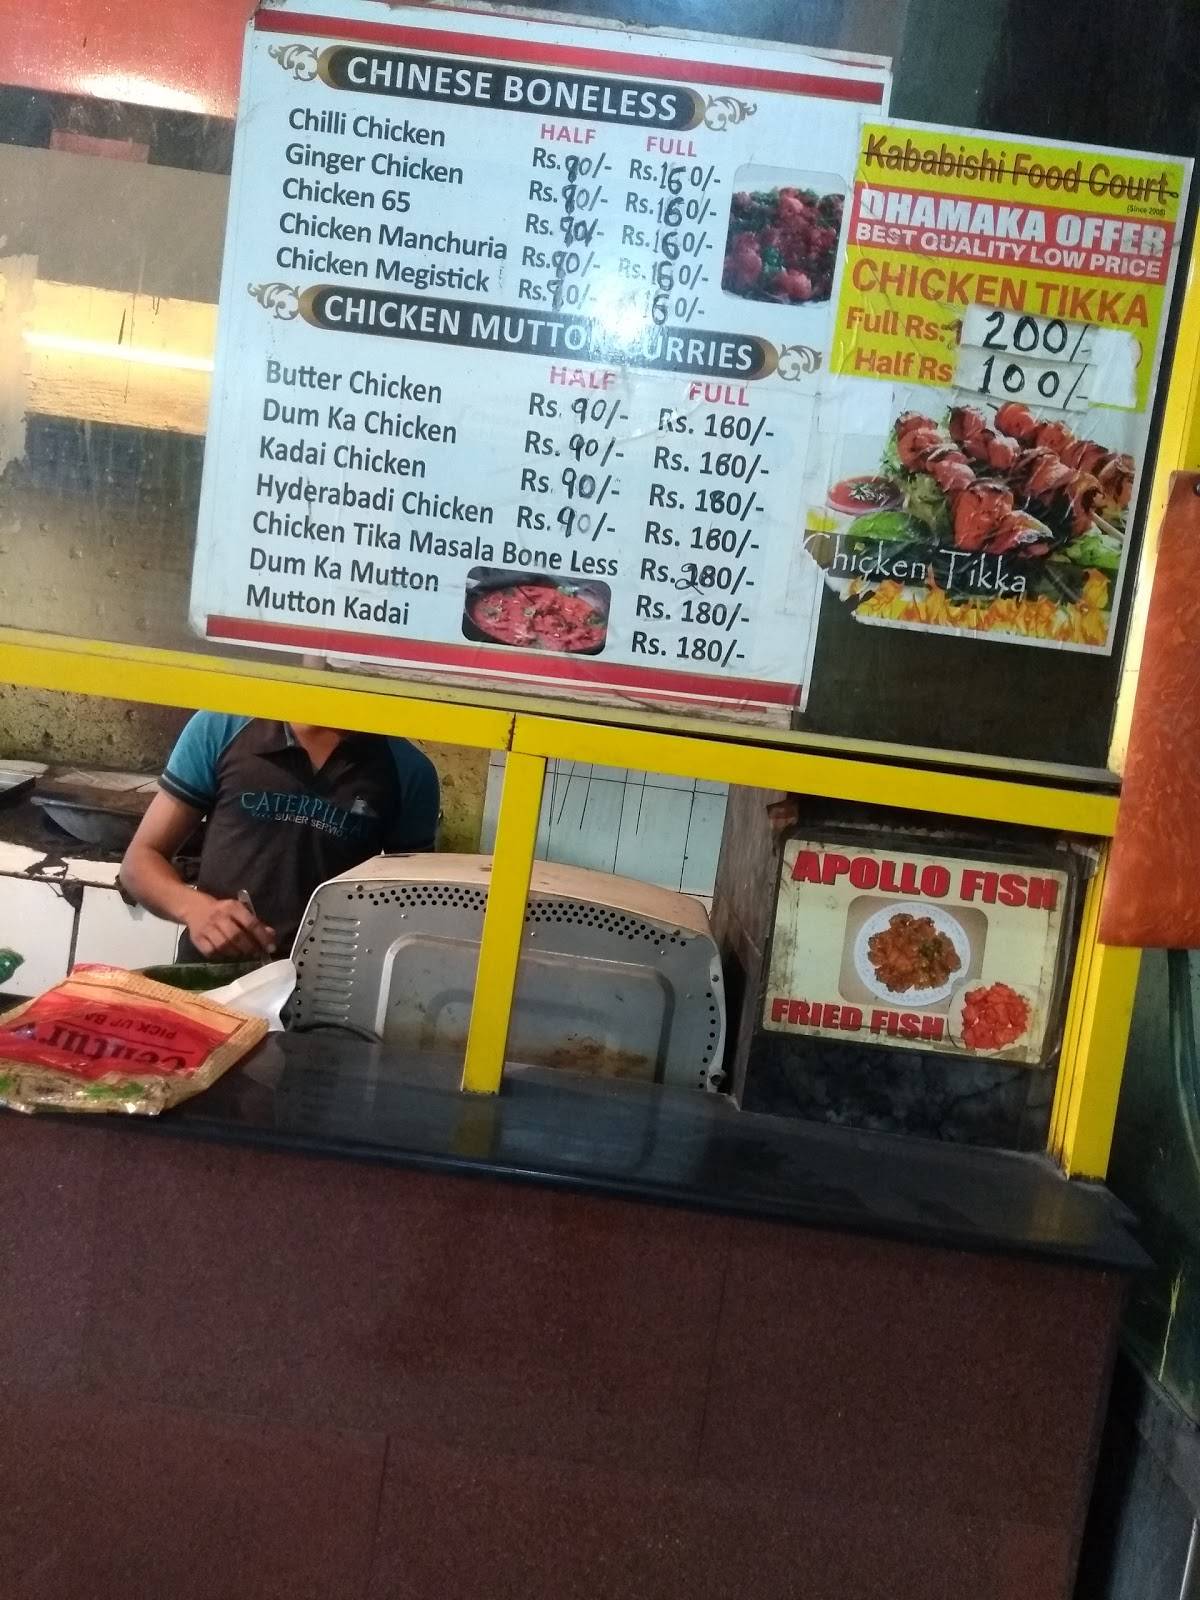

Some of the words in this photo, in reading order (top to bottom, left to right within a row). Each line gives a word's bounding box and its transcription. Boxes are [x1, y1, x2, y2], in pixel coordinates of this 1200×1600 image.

[347, 56, 492, 100] CHINESE
[504, 75, 678, 121] BONELESS
[289, 108, 346, 135] Chilli
[353, 115, 445, 147] Chicken
[540, 124, 597, 145] HALF
[646, 136, 697, 157] FULL
[285, 143, 365, 174] Ginger
[371, 154, 464, 184] Chicken
[864, 134, 1006, 184] Kababishi
[1011, 153, 1082, 192] Food
[1089, 163, 1169, 205] Court
[282, 177, 375, 209] Chicken
[382, 189, 411, 213] 65
[279, 212, 371, 243] Chicken
[378, 225, 508, 259] Manchuria
[860, 189, 1047, 243] DHAMAKA
[1056, 214, 1167, 258] OFFER
[276, 247, 368, 278] Chicken
[376, 259, 490, 293] Megistick
[855, 223, 918, 246] BEST
[920, 233, 1027, 262] QUALITY
[1030, 247, 1086, 268] LOW
[1090, 257, 1161, 280] PRICE
[852, 258, 1027, 311] CHICKEN
[1035, 282, 1149, 328] TIKKA
[324, 295, 461, 336] CHICKEN
[471, 313, 612, 353] MUTTO
[620, 325, 753, 369] URRIES
[846, 306, 899, 336] Full
[982, 311, 1092, 362] 200/-
[266, 360, 342, 390] Butter
[350, 370, 443, 404] Chicken
[549, 366, 617, 391] HALF
[854, 348, 913, 373] Half
[978, 355, 1088, 409] 100/-
[688, 382, 750, 407] FULL
[263, 398, 319, 427] Dum
[328, 406, 356, 431] Ka
[364, 410, 457, 444] Chicken
[259, 436, 326, 466] Kadai
[334, 445, 426, 478] Chicken
[256, 473, 394, 512] Hyderabadi
[402, 491, 494, 525] Chicken
[252, 510, 345, 544] Chicken
[353, 522, 401, 551] Tika
[410, 529, 494, 562] Masala
[502, 541, 562, 569] Bone
[570, 549, 619, 577] Less
[249, 547, 306, 576] Dum
[314, 554, 342, 580] Ka
[350, 560, 439, 592] Mutton
[940, 549, 1027, 594] Tikka
[246, 584, 336, 617] Mutton
[344, 595, 410, 626] Kadai
[681, 599, 750, 631] 180/-
[676, 636, 745, 668] 180/-
[791, 851, 951, 897] APOLLO
[959, 869, 1058, 910] FISH
[771, 998, 863, 1031] FRIED
[870, 1009, 945, 1042] FISH
